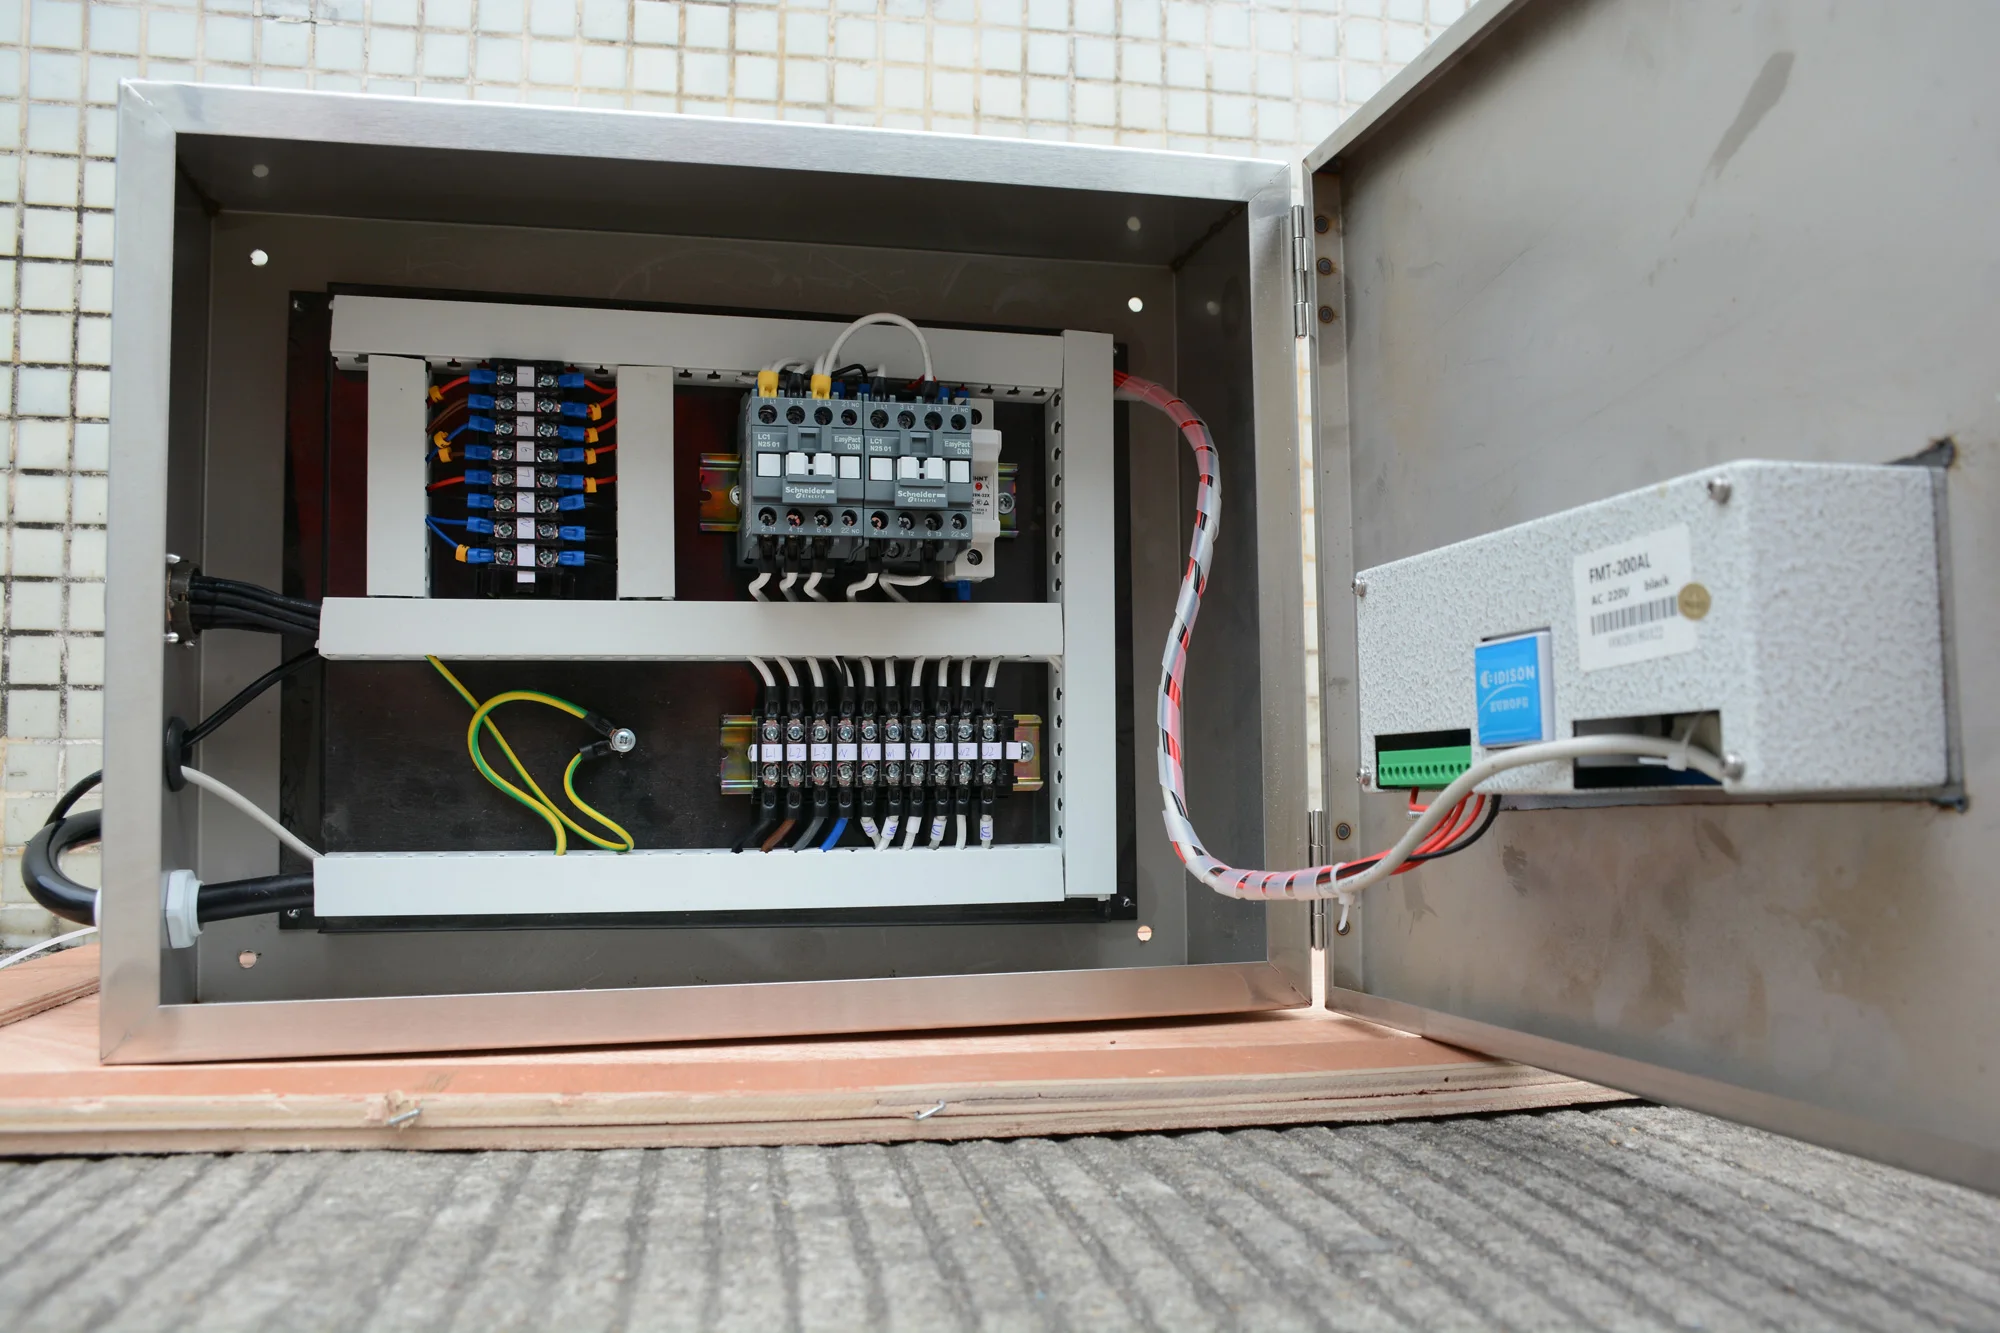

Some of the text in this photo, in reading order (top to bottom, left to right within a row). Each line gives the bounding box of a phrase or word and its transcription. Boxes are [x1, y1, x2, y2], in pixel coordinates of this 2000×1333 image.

[834, 436, 861, 444] EasyPact
[944, 440, 970, 448] EasyPact
[785, 486, 825, 494] Schneider
[897, 490, 936, 498] Schneider
[1588, 552, 1652, 584] FMT-200AL
[1591, 594, 1603, 606] AC
[1607, 586, 1630, 603] 220V
[765, 747, 776, 758] L1
[788, 747, 802, 758] L2
[813, 746, 827, 759] L3
